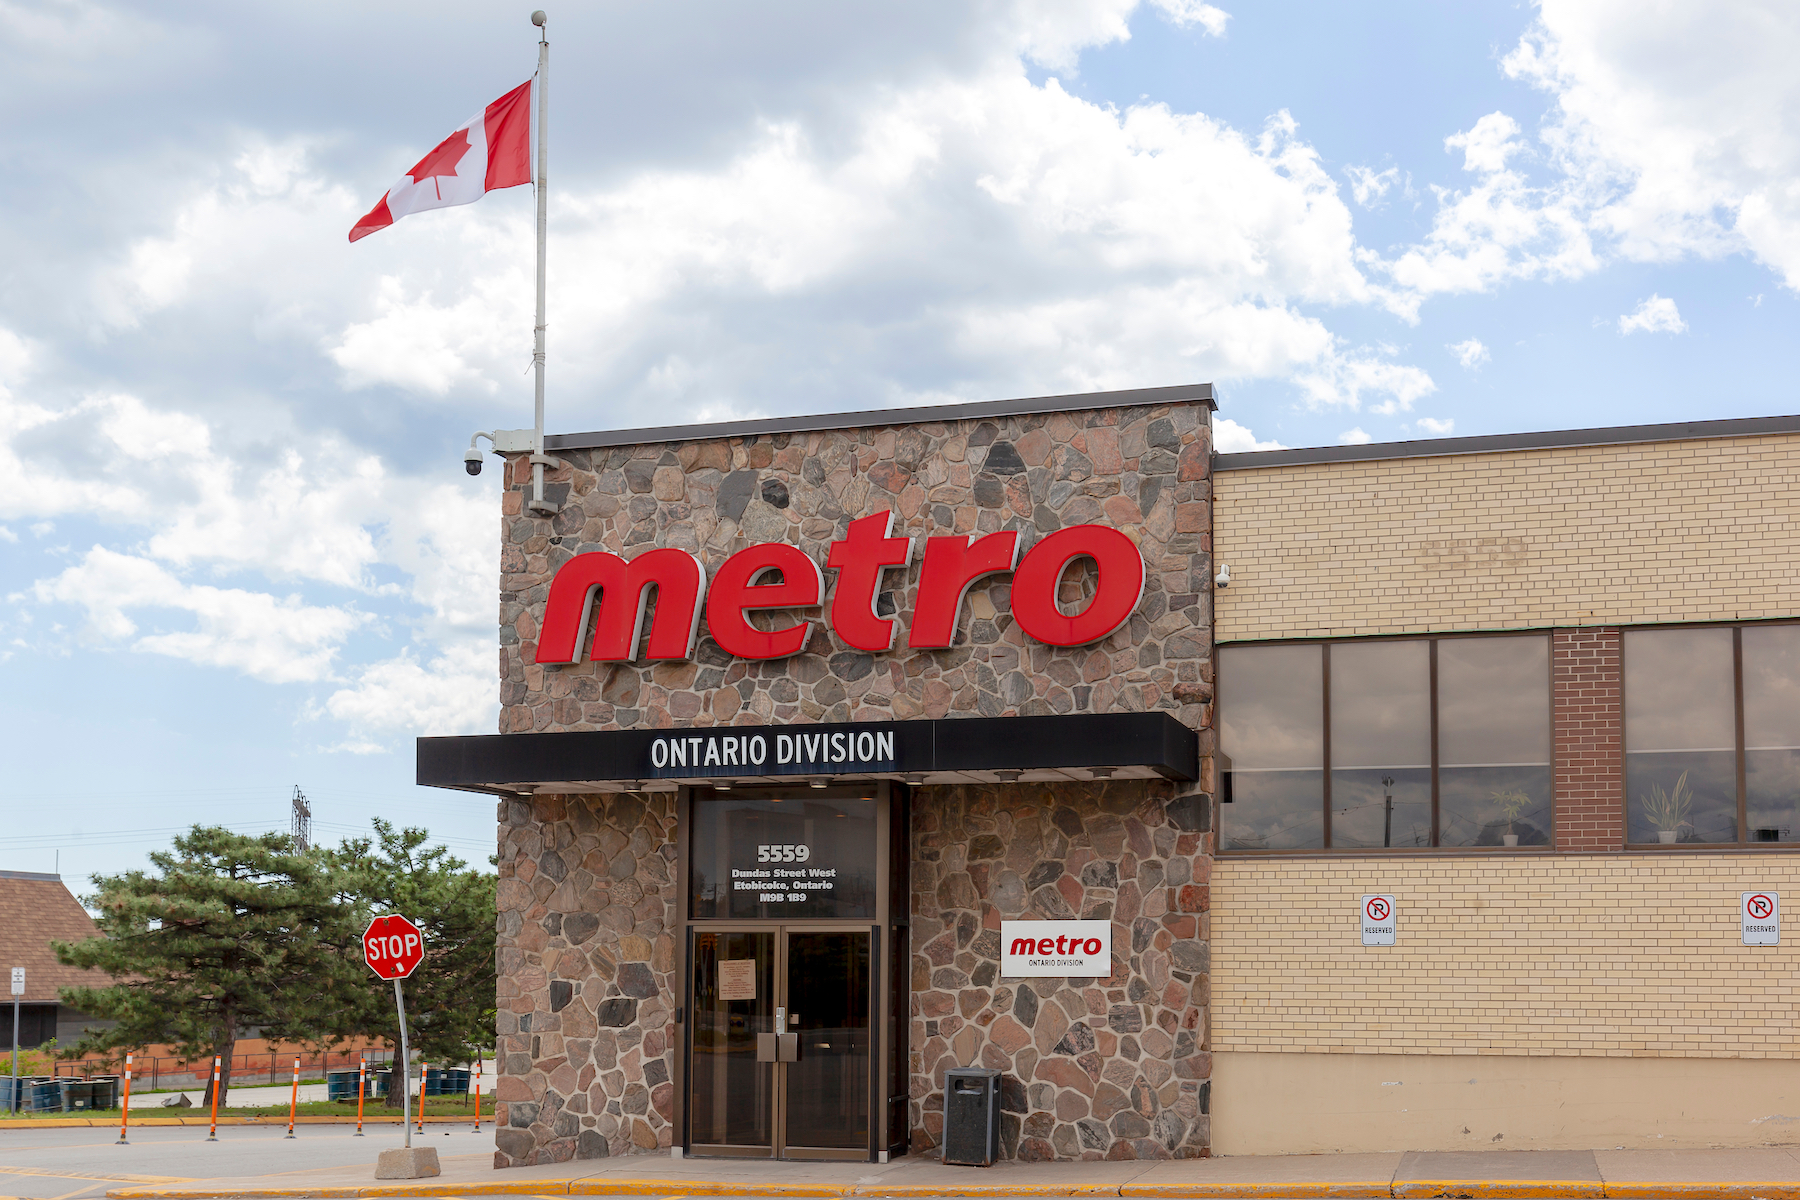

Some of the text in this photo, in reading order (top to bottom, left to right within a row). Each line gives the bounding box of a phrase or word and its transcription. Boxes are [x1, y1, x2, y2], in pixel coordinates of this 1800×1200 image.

[535, 509, 1146, 664] metro
[651, 731, 894, 768] ONTARIO DIVISION
[757, 844, 811, 863] 5559
[731, 868, 836, 878] Dundas Street West
[733, 880, 834, 891] Etobicoke, Ontario
[759, 893, 807, 903] M9B 1B9
[1364, 926, 1393, 934] RESERVED
[1745, 925, 1776, 933] RESERVED
[368, 933, 419, 961] STOP
[1009, 934, 1102, 956] metro
[1028, 959, 1084, 967] ONTARIO DIVISION
